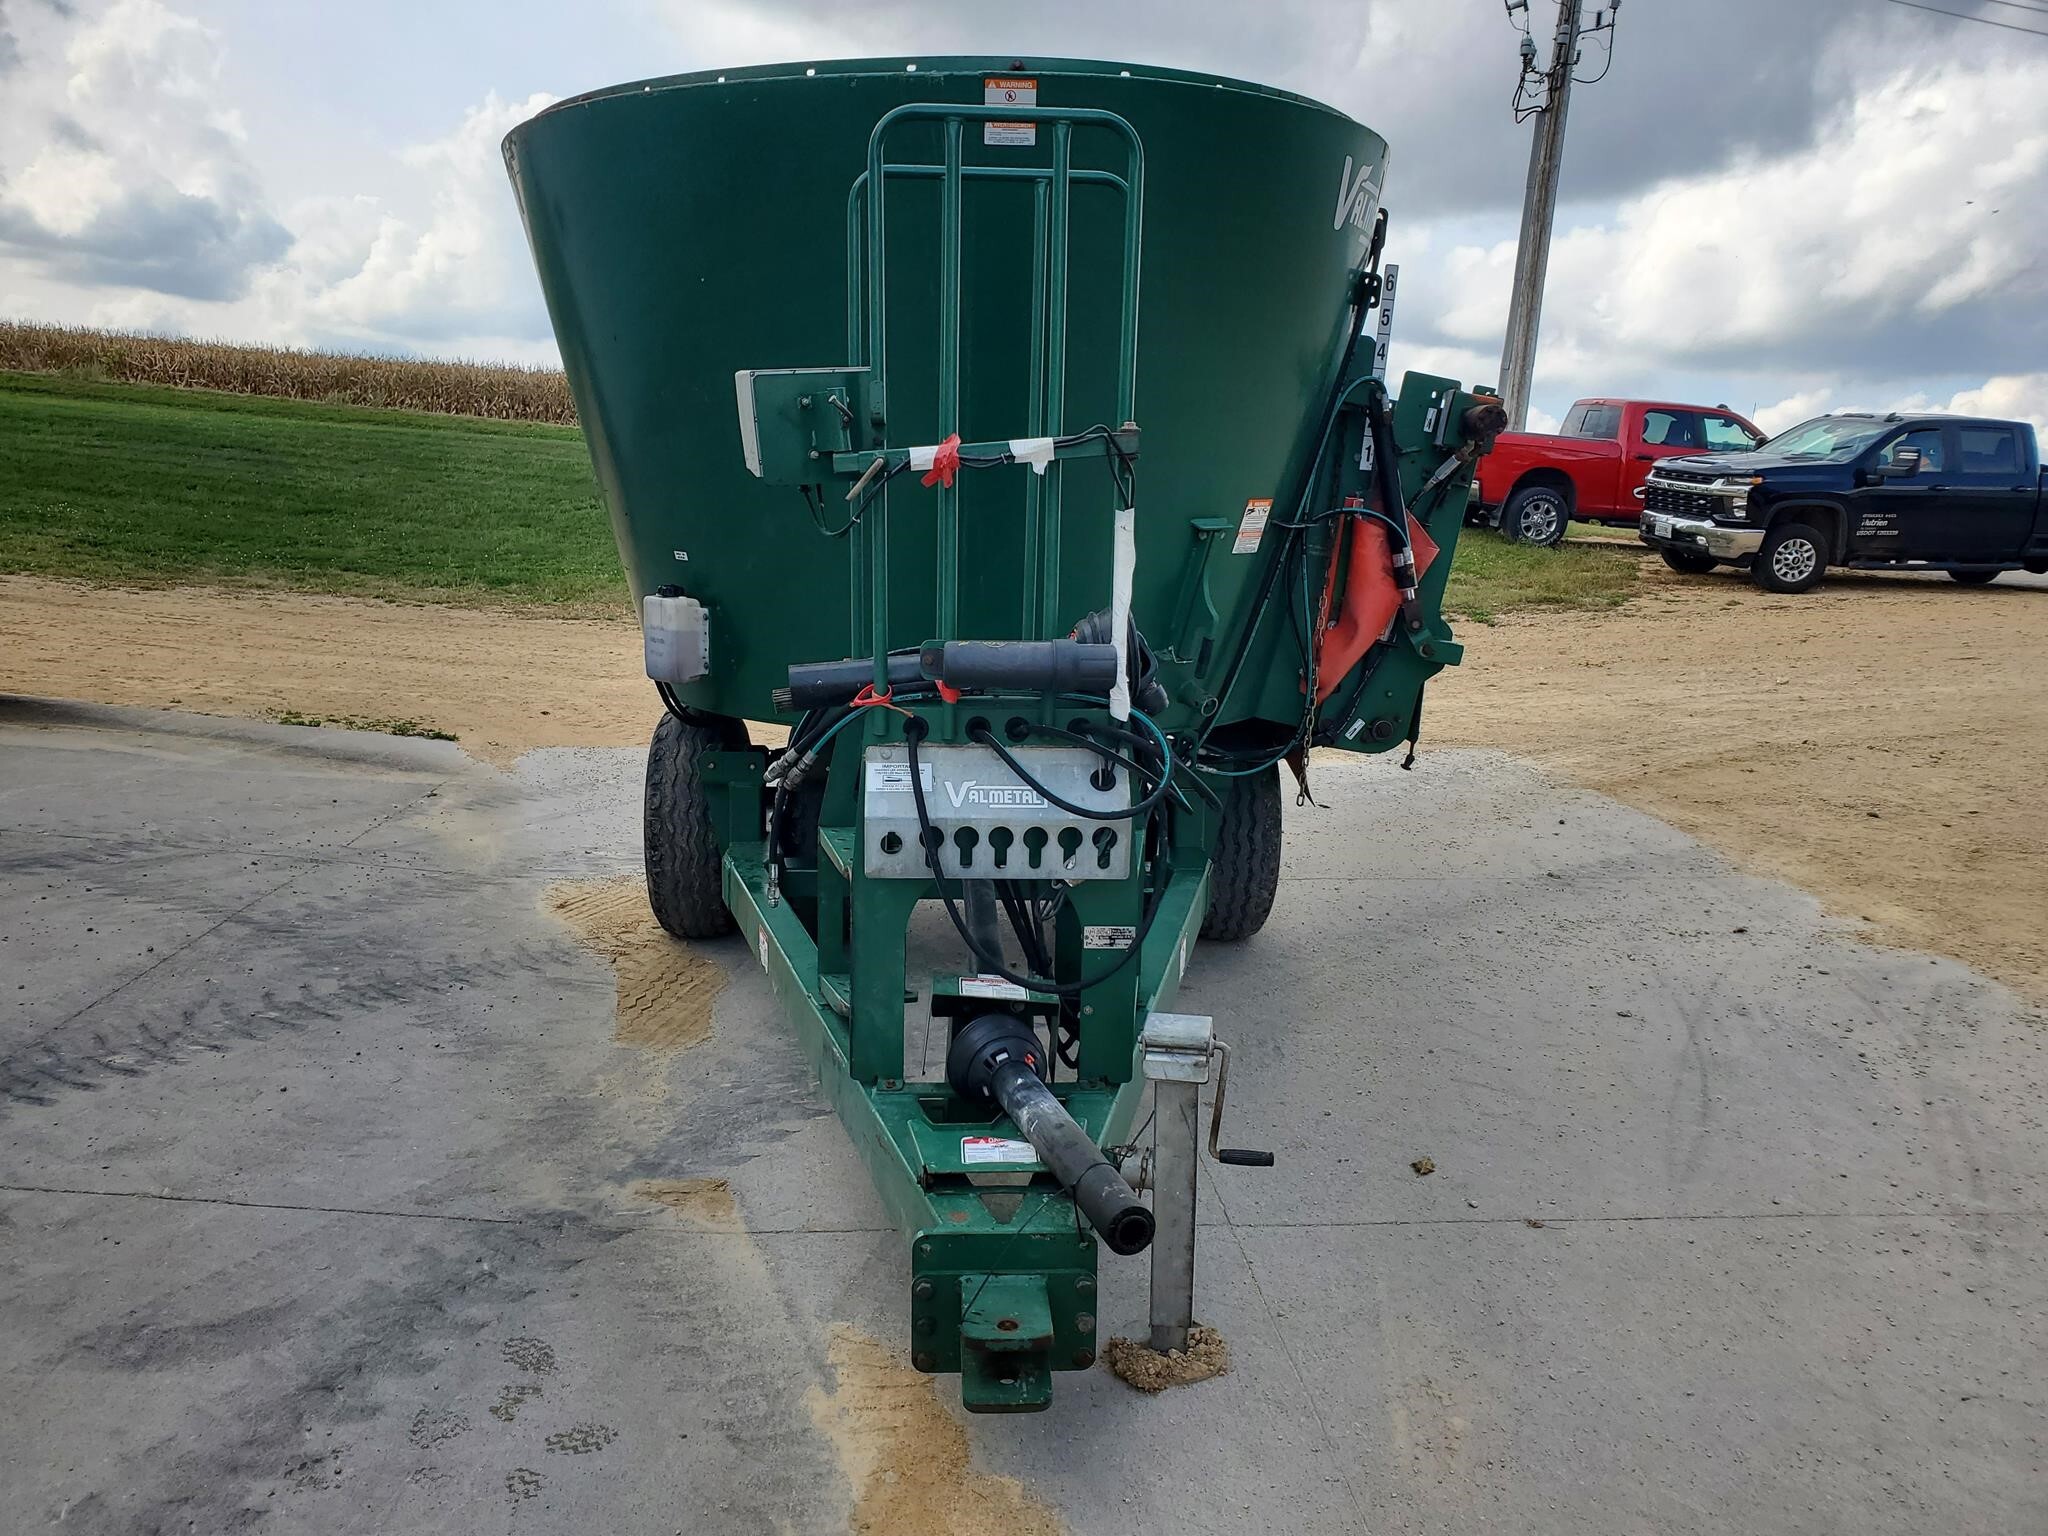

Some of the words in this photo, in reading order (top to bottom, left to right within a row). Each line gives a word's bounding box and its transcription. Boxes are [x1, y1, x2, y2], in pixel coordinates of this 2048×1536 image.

[1000, 81, 1033, 89] WARNING
[1385, 273, 1395, 292] 6
[1381, 308, 1391, 327] 5
[1376, 342, 1386, 361] 4
[1365, 444, 1372, 462] 1
[944, 780, 1041, 808] VALMETAL
